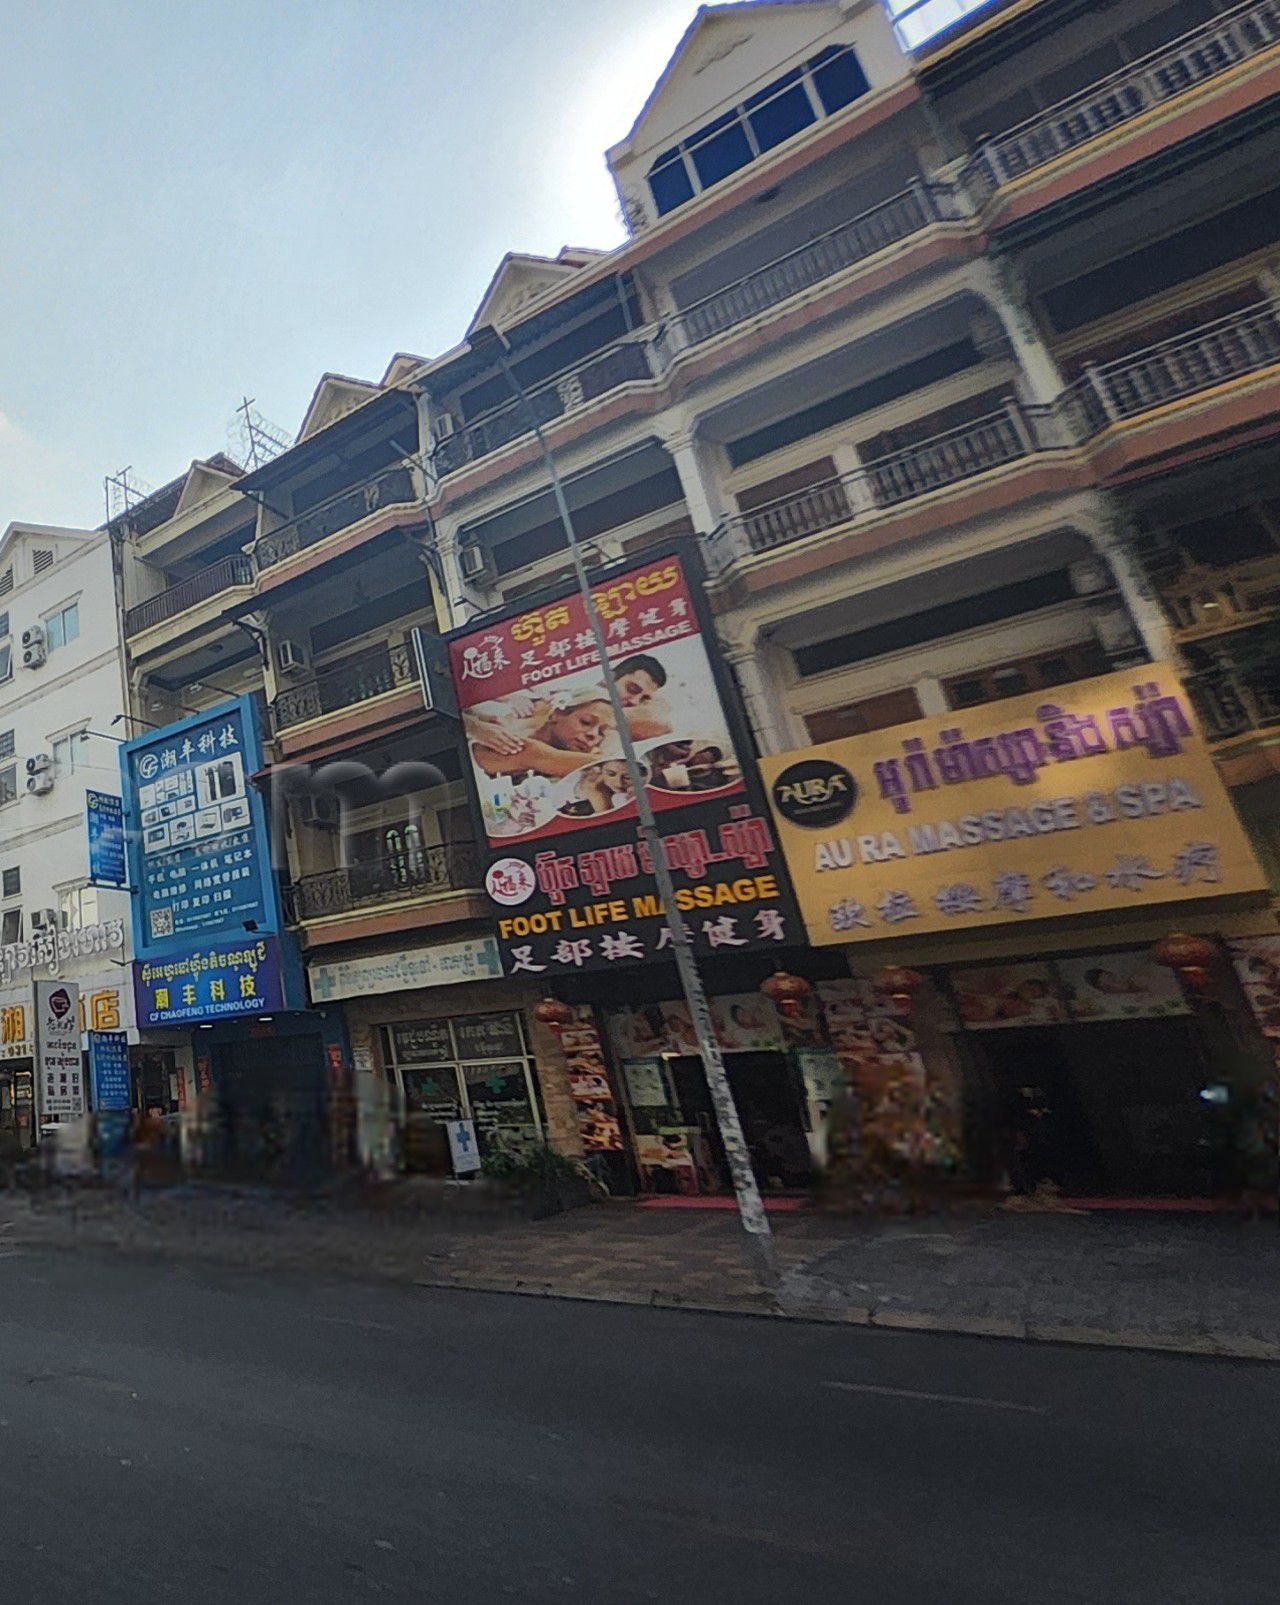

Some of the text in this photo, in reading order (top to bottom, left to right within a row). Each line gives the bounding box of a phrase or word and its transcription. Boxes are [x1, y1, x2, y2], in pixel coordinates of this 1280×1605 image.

[521, 619, 693, 686] FOOT LIFE MASSAGE
[160, 724, 239, 770] 潮丰科技
[910, 800, 1083, 856] MASSAGE
[1117, 777, 1202, 821] SPA
[498, 911, 563, 940] FOOT
[569, 899, 629, 928] LIFE
[160, 1004, 205, 1020] CHAOFENG
[205, 998, 265, 1015] TECHNOLOGY
